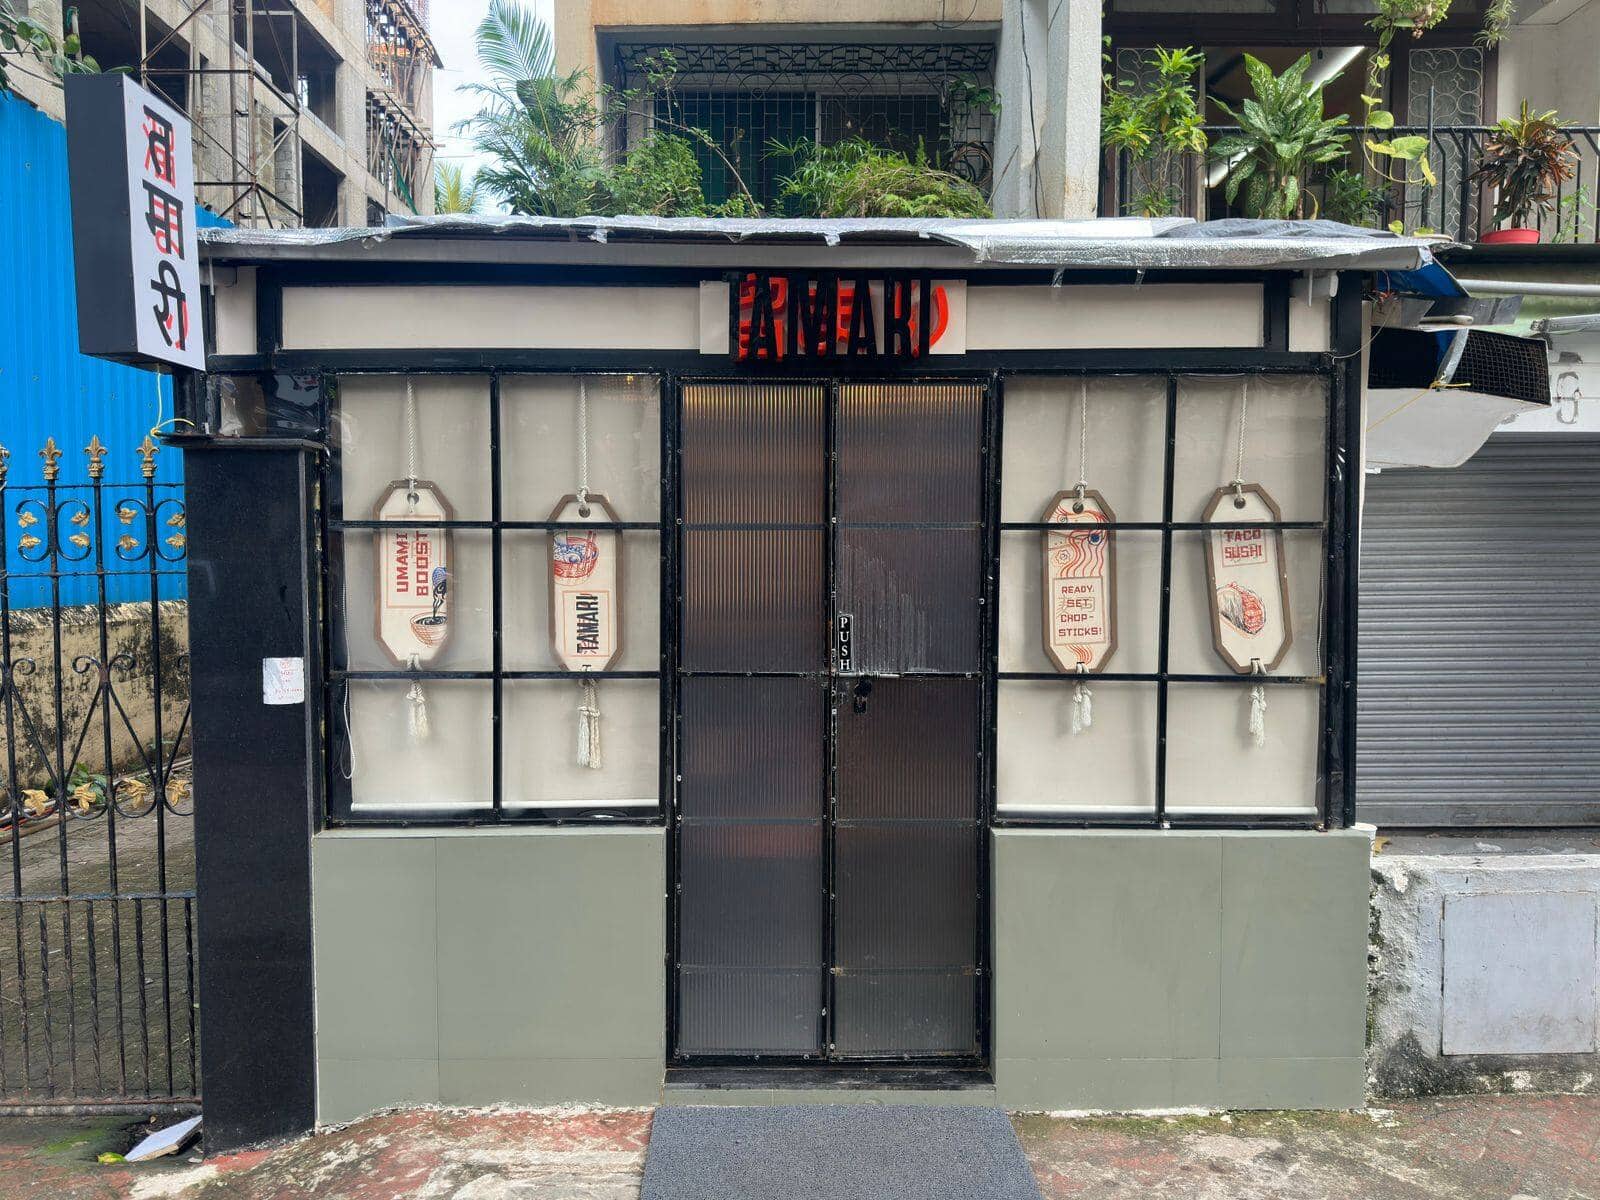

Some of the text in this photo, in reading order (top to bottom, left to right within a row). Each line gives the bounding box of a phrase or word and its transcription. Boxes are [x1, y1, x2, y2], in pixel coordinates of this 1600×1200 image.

[1223, 528, 1262, 543] TACO
[1224, 544, 1263, 559] SUSHI
[396, 532, 409, 593] UMAMI
[415, 531, 429, 597] BOOST
[576, 594, 599, 654] TAMARI
[839, 617, 851, 670] PUSH
[1058, 627, 1102, 637] STICKS!
